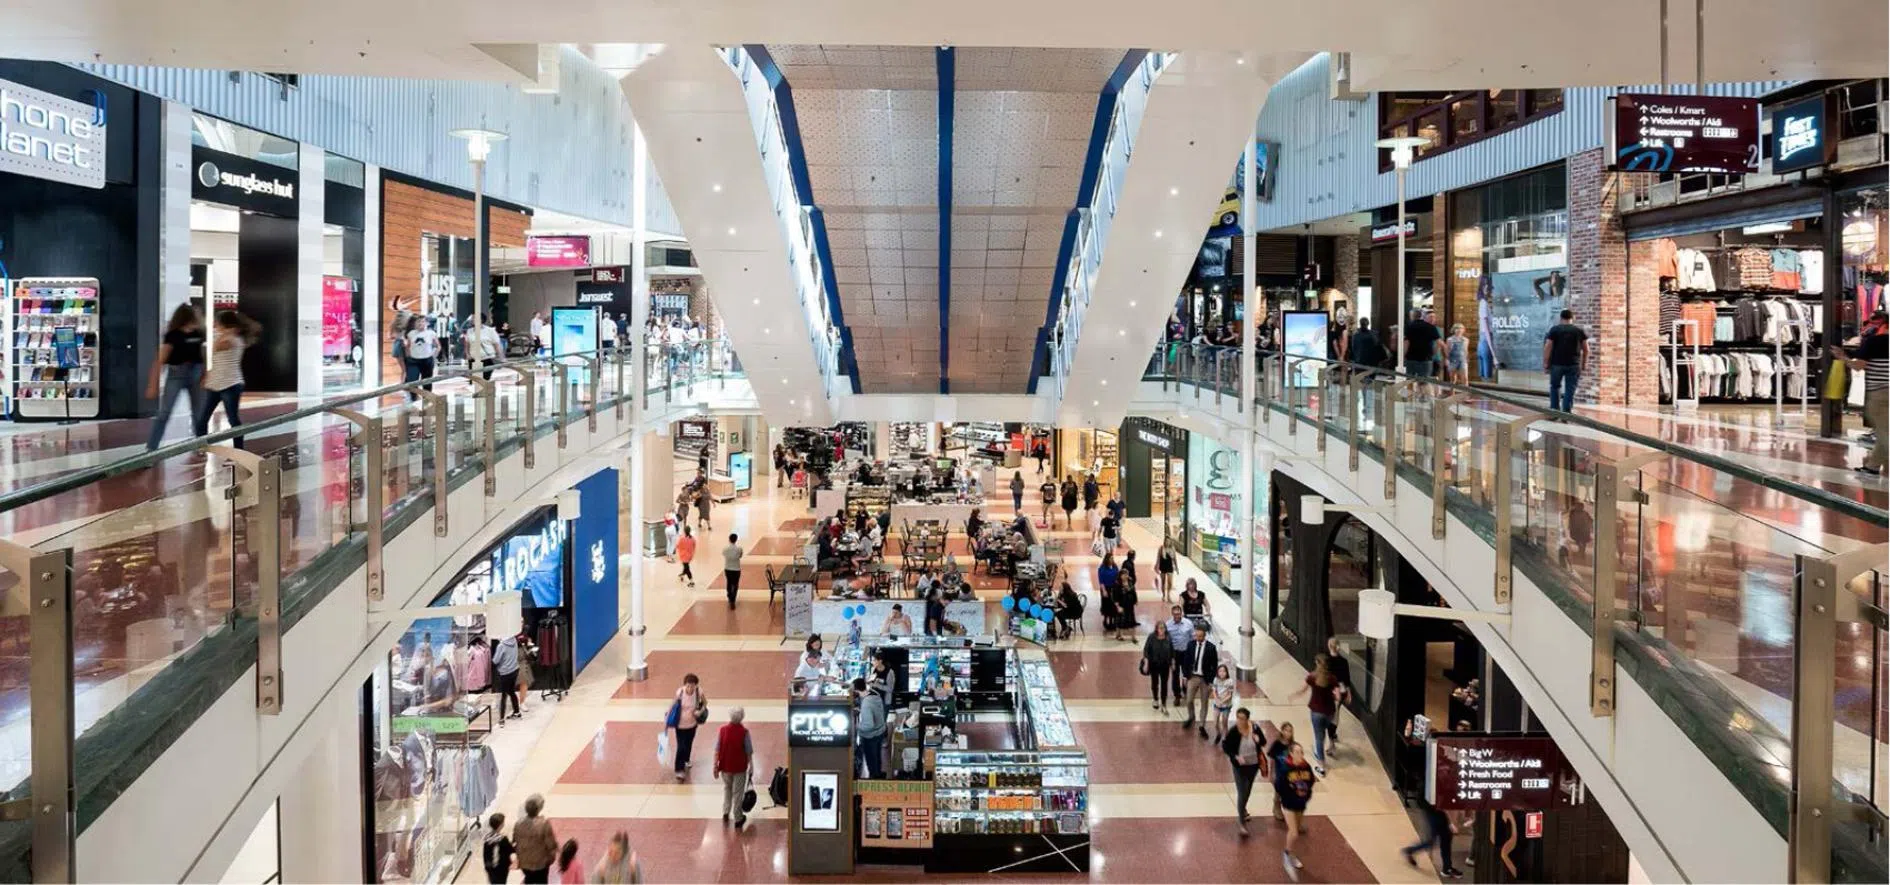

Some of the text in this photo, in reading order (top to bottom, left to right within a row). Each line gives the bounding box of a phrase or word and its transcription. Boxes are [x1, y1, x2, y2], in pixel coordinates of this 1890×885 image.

[1650, 105, 1673, 114] Coles
[1680, 106, 1706, 115] Kmart
[1650, 116, 1701, 126] Woolworths
[1706, 118, 1722, 127] Aldi
[1650, 127, 1693, 137] Restrooms
[1747, 144, 1758, 168] 2
[221, 171, 293, 199] sunglass hut
[429, 274, 455, 296] JUST
[434, 295, 453, 317] DO
[1470, 760, 1519, 768] Woolworths
[1525, 760, 1541, 768] Aldi
[1468, 770, 1513, 778] Fresh Food
[1468, 780, 1512, 789] Restrooms
